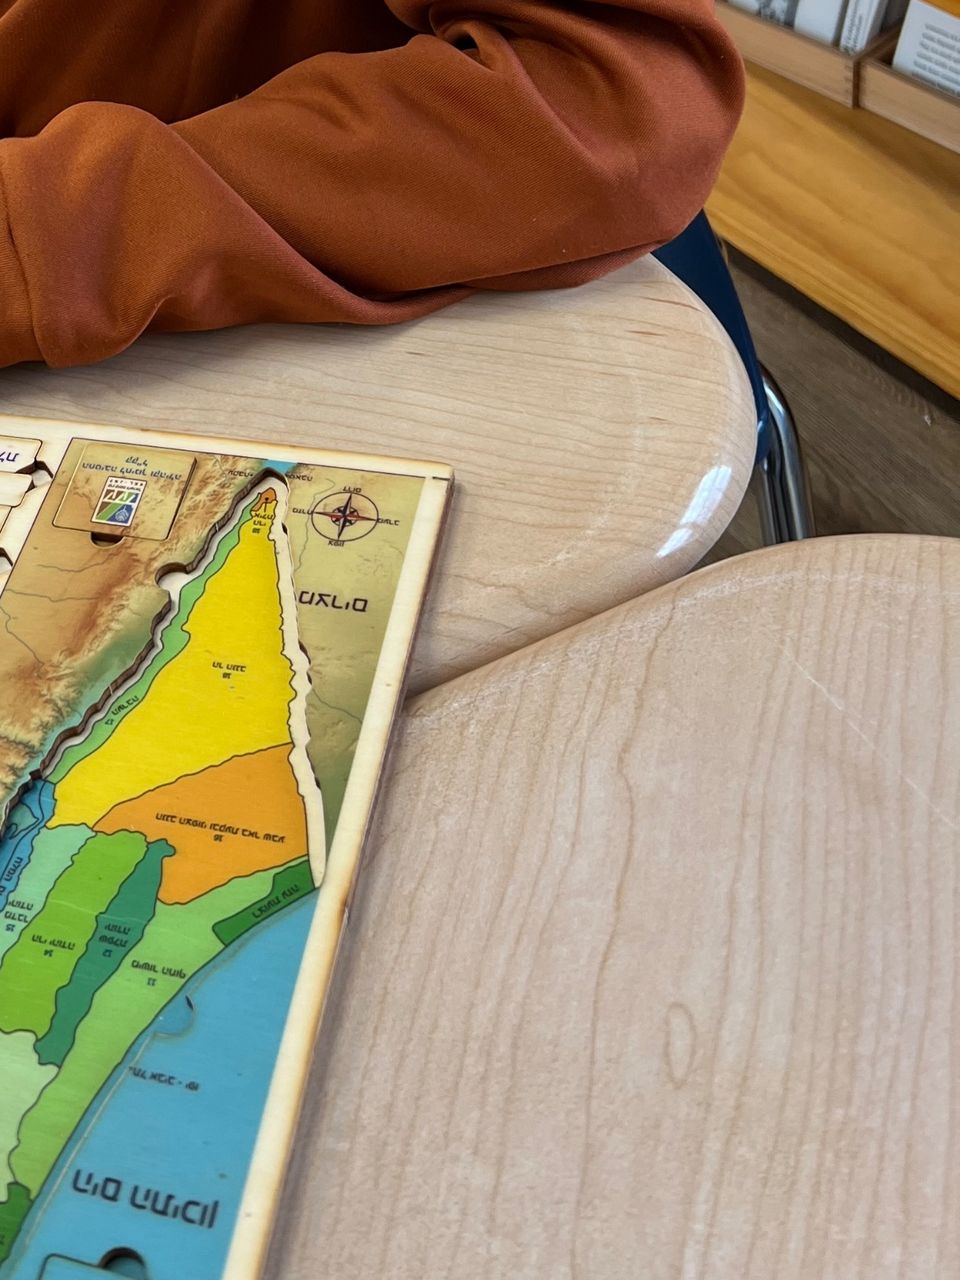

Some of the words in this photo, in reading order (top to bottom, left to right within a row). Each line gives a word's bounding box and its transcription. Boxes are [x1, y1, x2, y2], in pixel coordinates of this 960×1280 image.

[82, 462, 118, 473] החטיבה
[120, 467, 146, 476] לחינוך
[150, 470, 182, 481] וקהילה
[254, 512, 274, 520] אילת
[298, 590, 368, 613] מצרים
[154, 812, 177, 823] הנגב
[241, 828, 261, 840] באר
[263, 833, 286, 844] שבע
[4, 911, 28, 923] מדבר
[32, 934, 47, 944] הרי
[49, 938, 76, 951] יהודה
[131, 959, 158, 974] מישור
[162, 966, 187, 979] החוף
[72, 1169, 122, 1203] הים
[129, 1185, 220, 1229] התיכון
